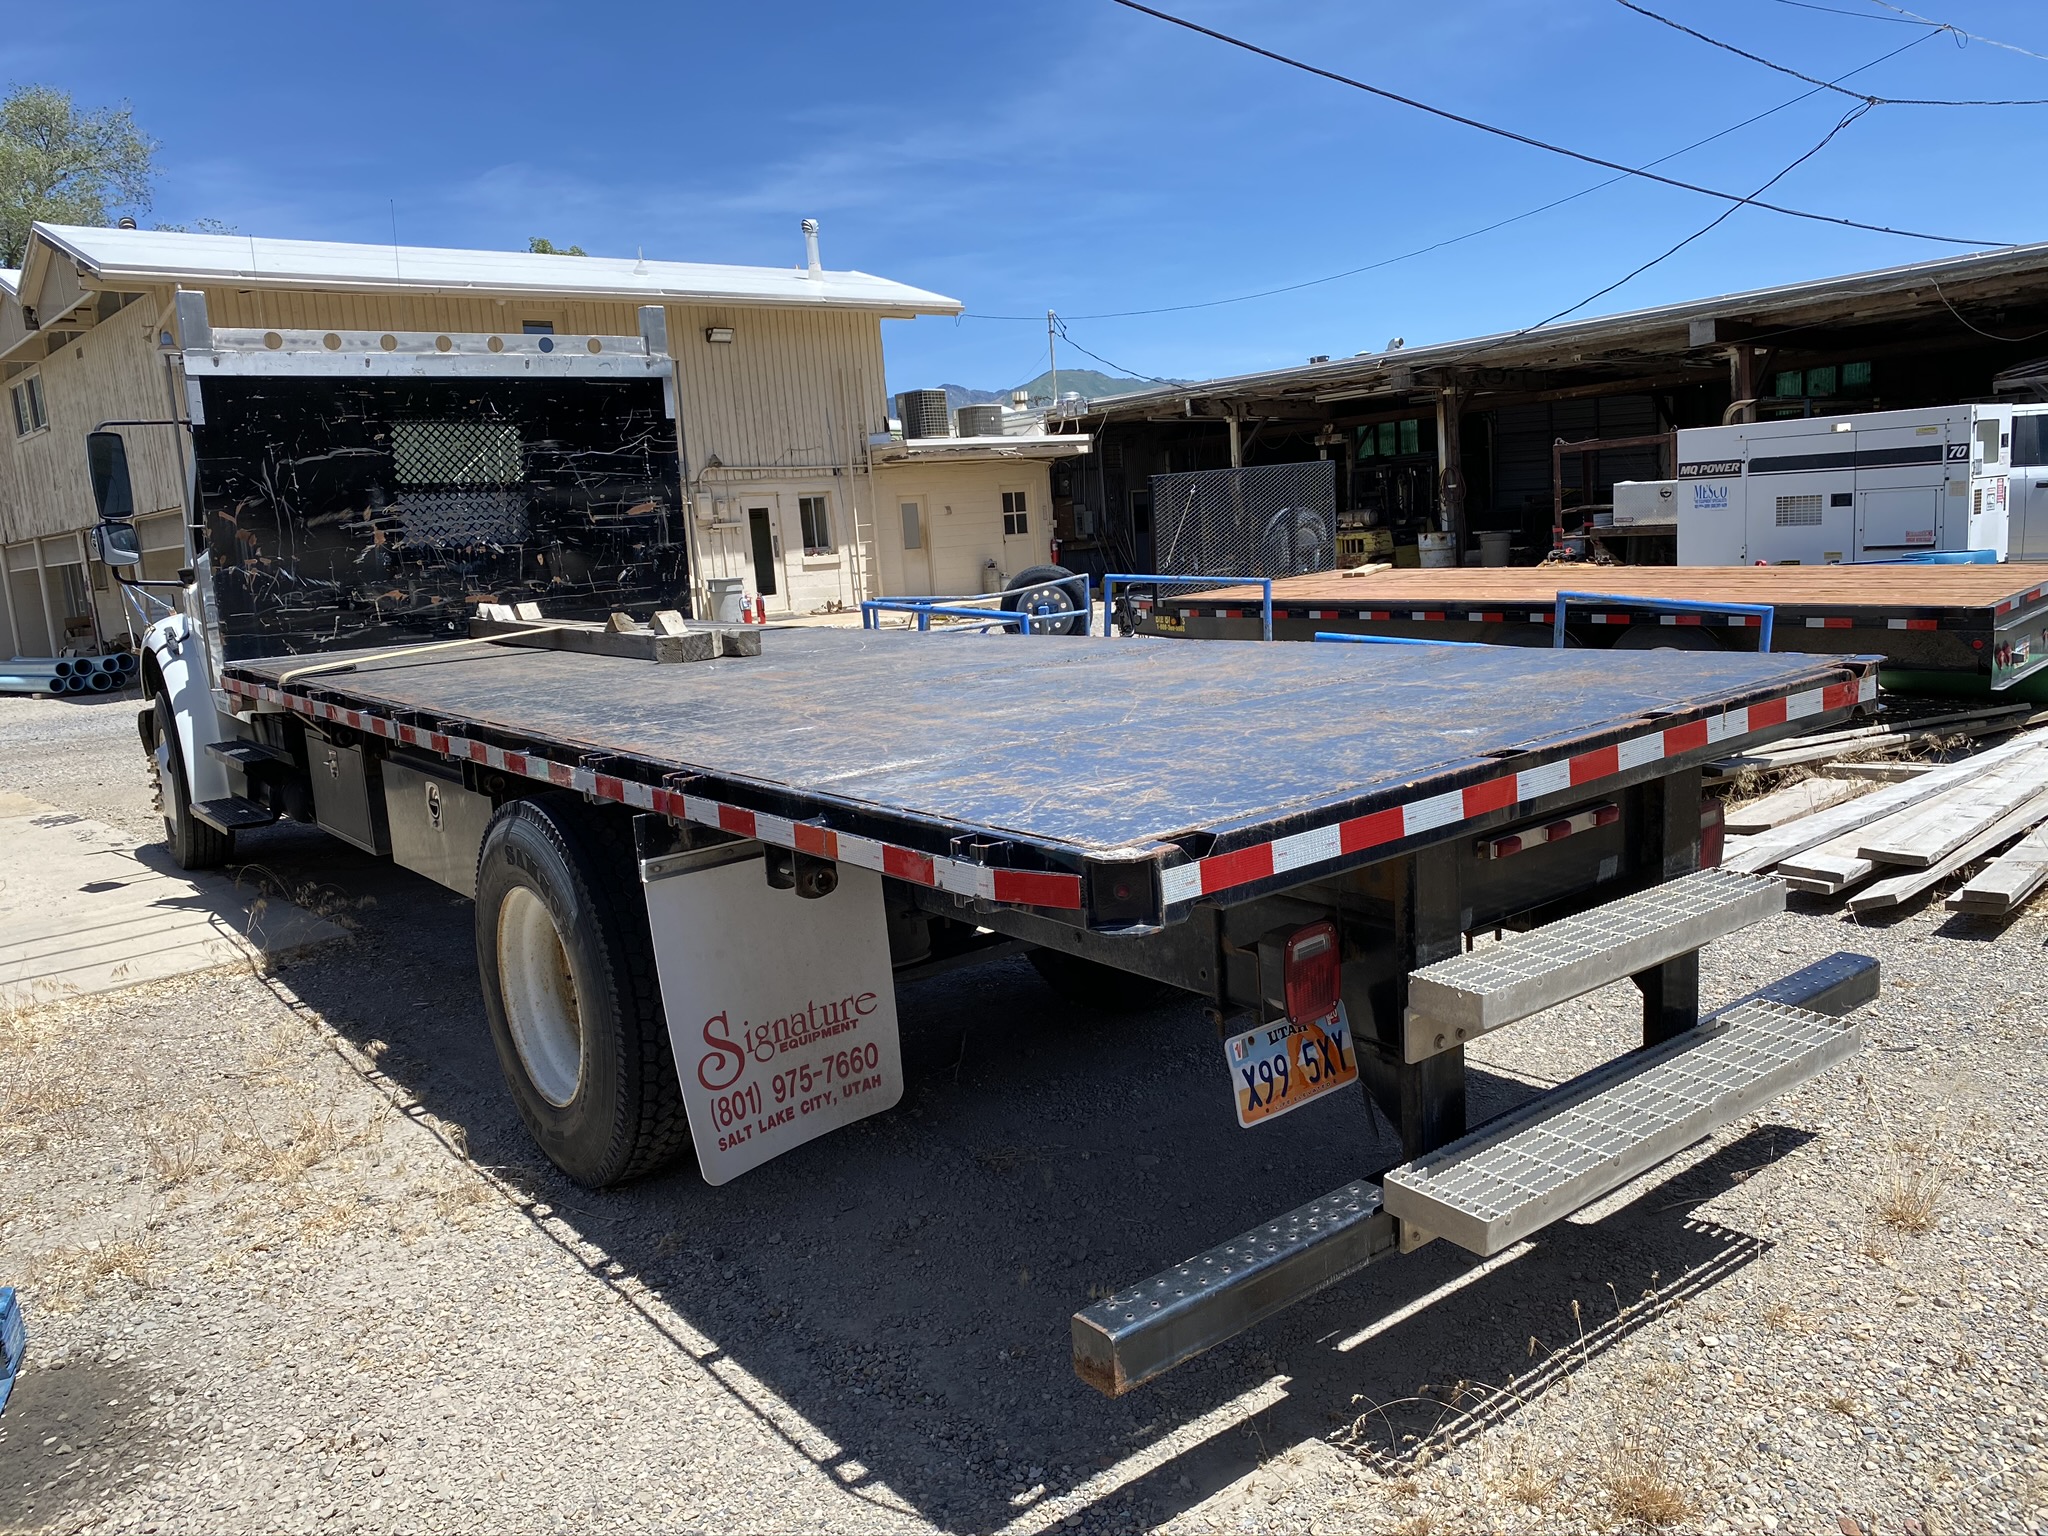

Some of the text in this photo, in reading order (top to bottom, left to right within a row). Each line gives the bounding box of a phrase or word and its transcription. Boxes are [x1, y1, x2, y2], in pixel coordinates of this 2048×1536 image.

[1680, 462, 1740, 475] MQ POWER
[1949, 445, 1967, 458] 70
[697, 992, 878, 1091] Signature
[779, 1018, 859, 1053] EQUIPMENT
[1242, 1030, 1346, 1111] X99 5XY
[711, 1042, 879, 1132] (801) 975-7660
[718, 1074, 882, 1152] SALT LAKE CITY, UTAH
